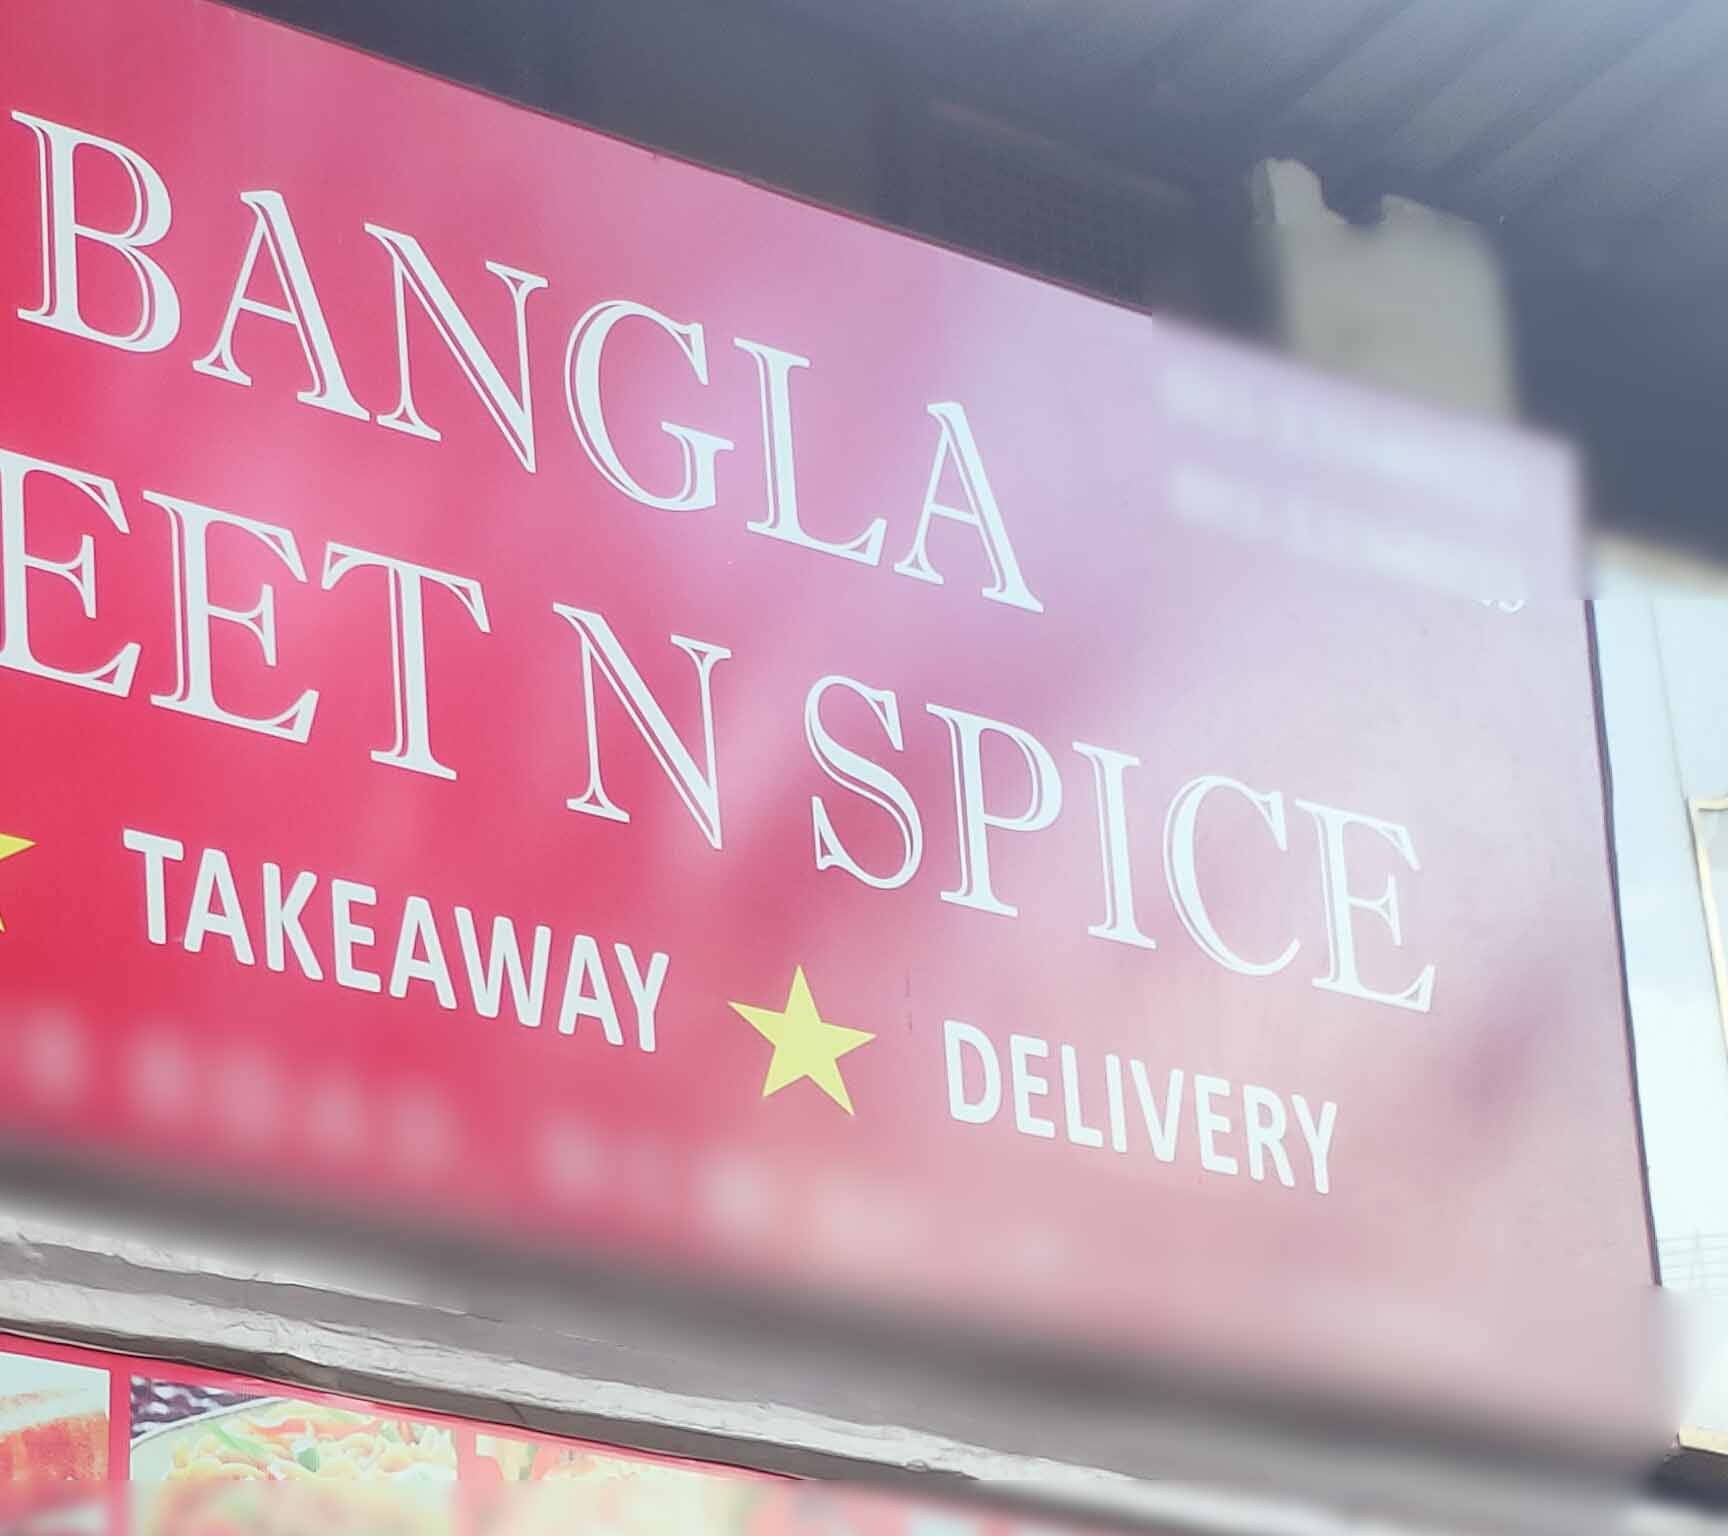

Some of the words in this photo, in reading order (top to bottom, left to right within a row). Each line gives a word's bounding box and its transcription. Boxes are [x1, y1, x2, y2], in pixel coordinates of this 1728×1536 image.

[11, 110, 1044, 613] BANGLA
[123, 828, 672, 1056] TAKEAWAY
[946, 1020, 1342, 1196] DELIVERY
[550, 605, 732, 852] N
[804, 674, 1438, 1013] SPICE
